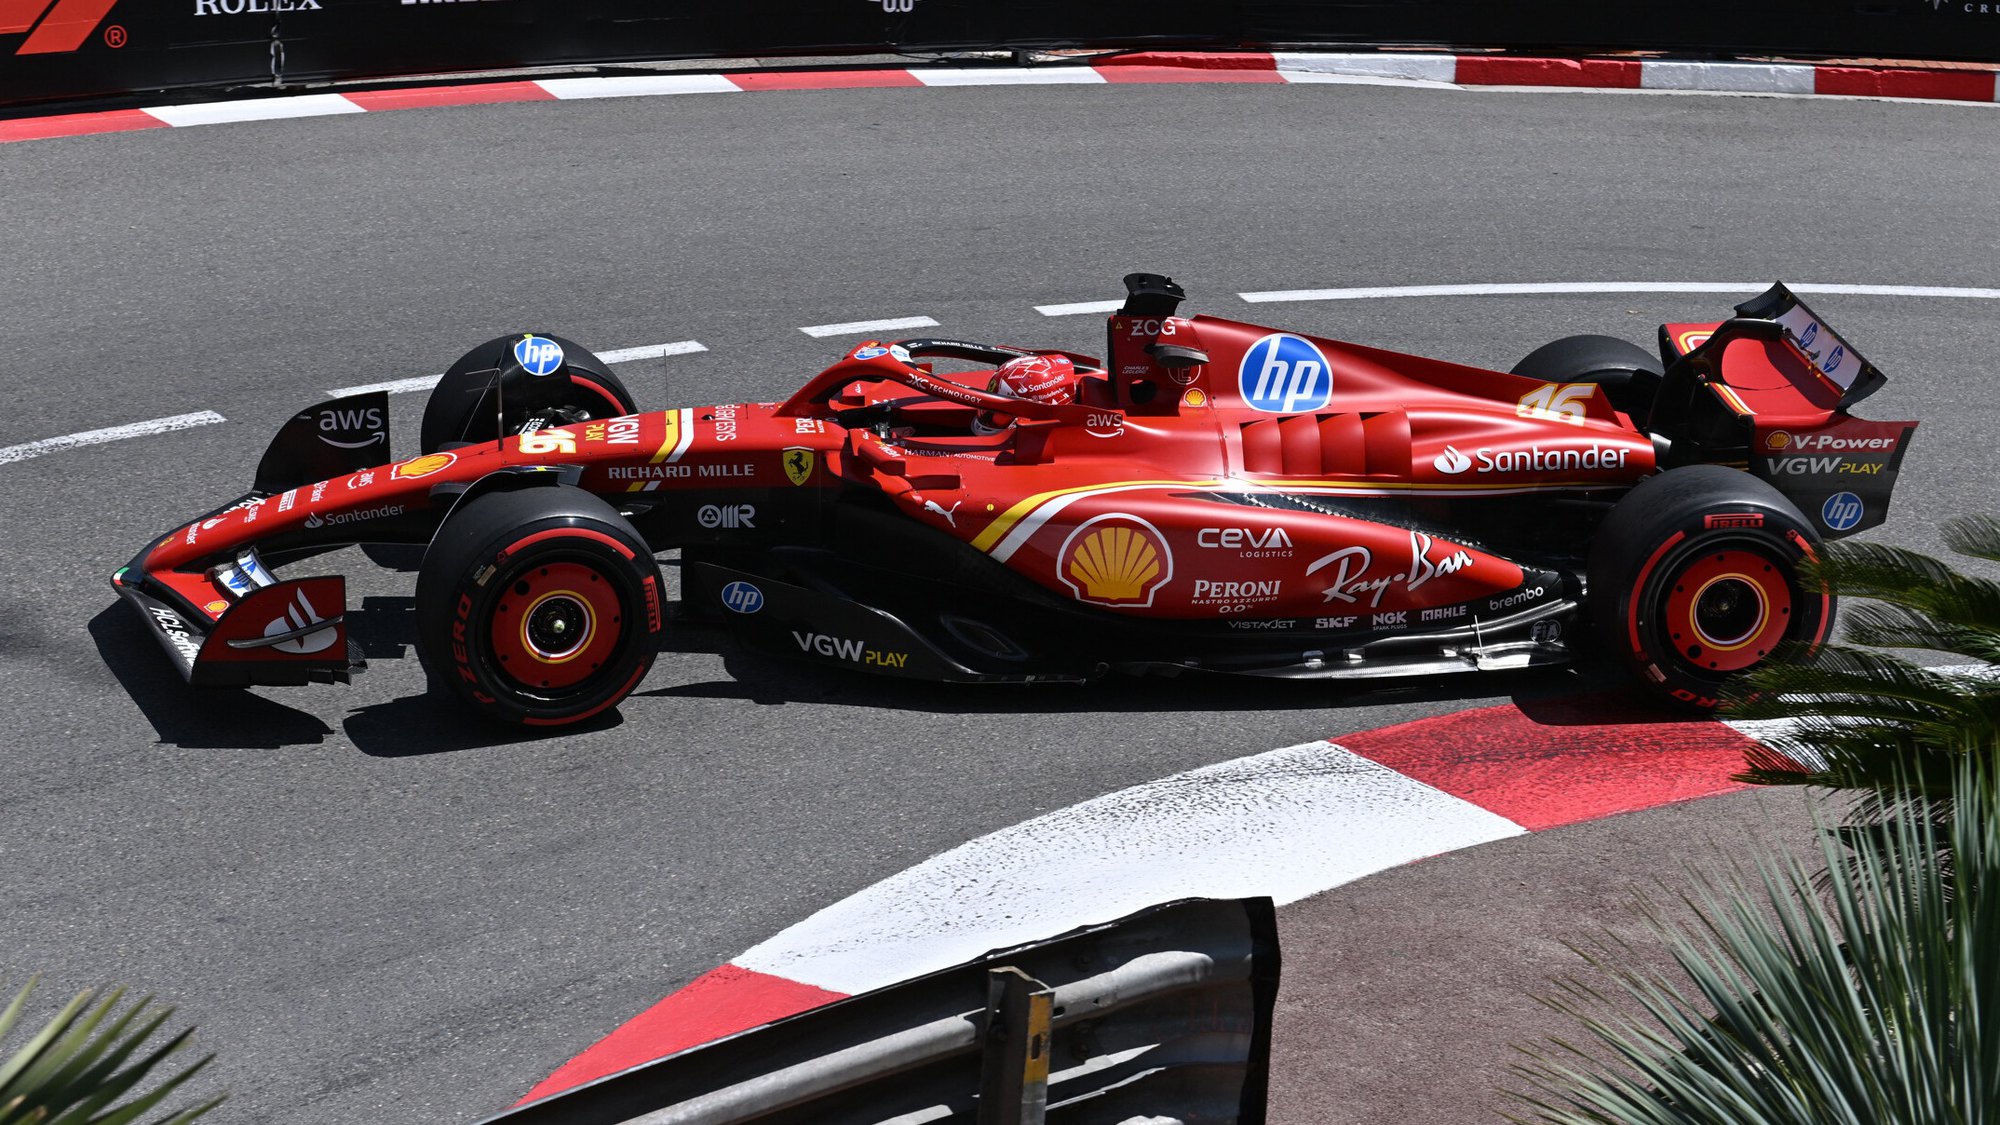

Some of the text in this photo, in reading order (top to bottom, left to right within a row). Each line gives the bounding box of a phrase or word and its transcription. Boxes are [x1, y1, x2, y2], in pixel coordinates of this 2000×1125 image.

[1131, 319, 1176, 336] ZCG
[523, 338, 562, 376] hp
[1028, 373, 1066, 393] Santander
[1252, 334, 1323, 412] hp
[906, 373, 982, 404] DXC TECHNOLOGY
[320, 407, 382, 431] aws
[607, 413, 640, 445] VGW
[1086, 413, 1123, 427] aws
[1794, 434, 1894, 450] V-Power
[904, 448, 951, 458] HARMAN
[953, 453, 995, 462] AUTOMOTIVE
[1475, 444, 1630, 473] Santander
[608, 464, 755, 480] RICHARD MILLE
[1766, 456, 1884, 476] VGW PLAY
[325, 503, 405, 526] Santander
[1704, 513, 1765, 529] PIRELLI
[1828, 493, 1858, 530] hp
[1239, 550, 1293, 558] LOGISTICS
[728, 582, 759, 613] hp
[1193, 579, 1282, 598] PERONI
[641, 575, 661, 634] PIRELLI
[1232, 596, 1278, 604] AZZURRO
[1489, 586, 1544, 612] brembo
[1315, 616, 1358, 629] SKF
[1372, 610, 1408, 626] NGK
[1421, 605, 1467, 622] MAHLE
[452, 592, 478, 685] ZERO
[792, 630, 909, 668] VGW PLAY
